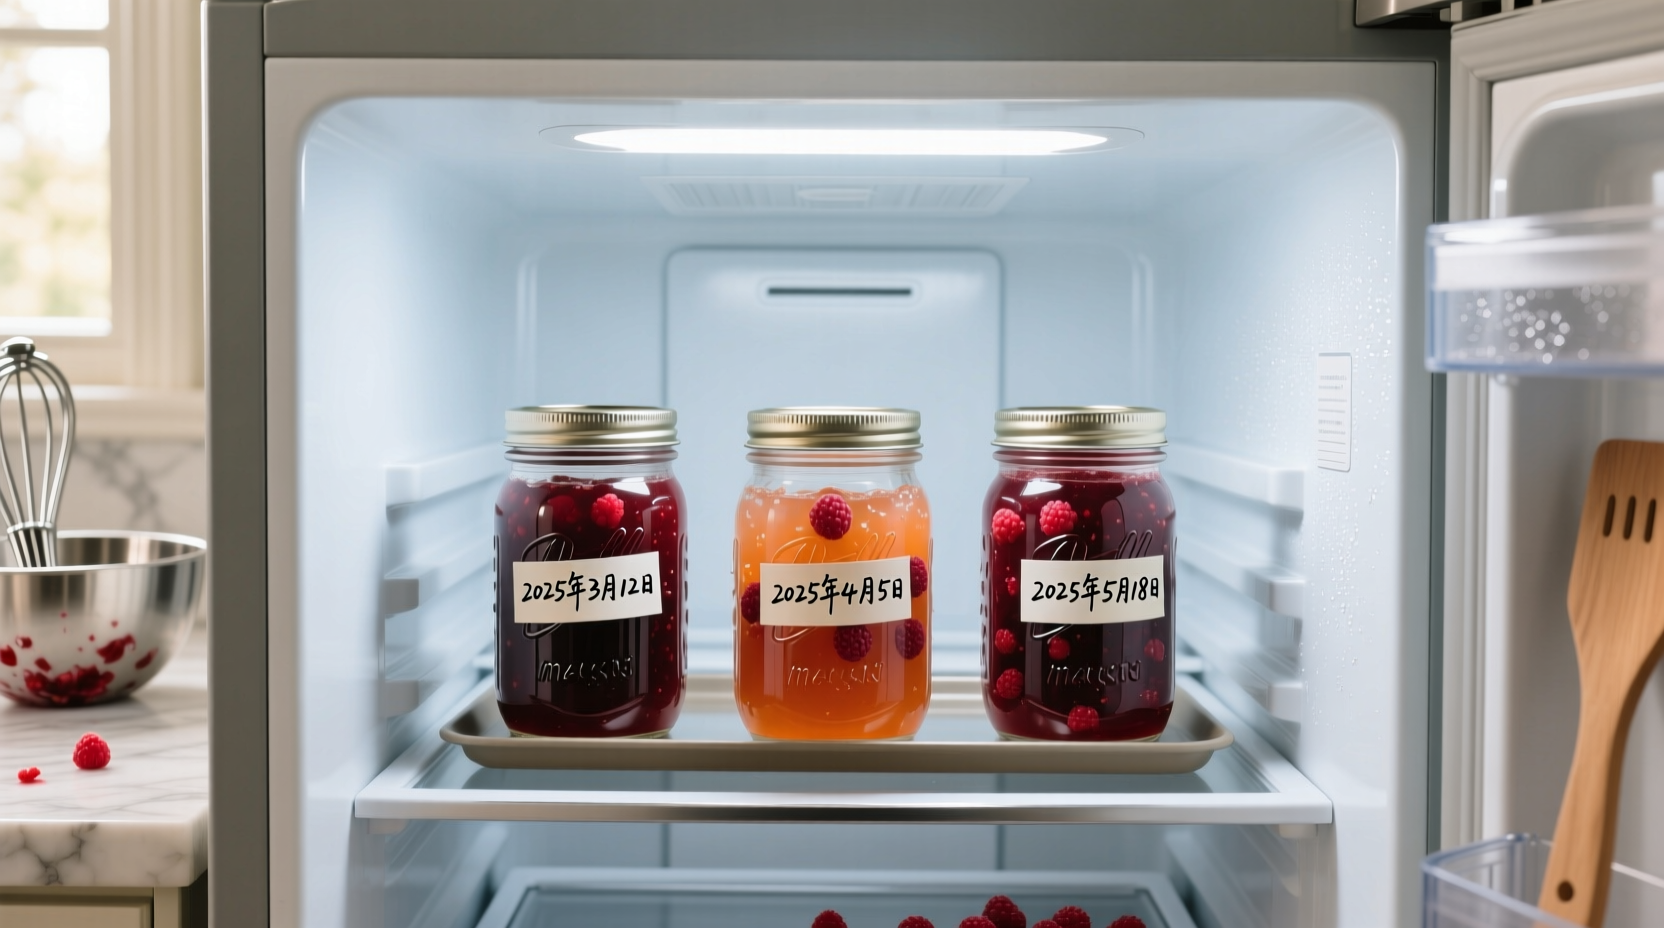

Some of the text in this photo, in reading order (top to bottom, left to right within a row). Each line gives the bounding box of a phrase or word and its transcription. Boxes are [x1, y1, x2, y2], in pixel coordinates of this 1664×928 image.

[522, 571, 652, 611] 2025年3月12日
[772, 574, 902, 615] 2025年4月5日
[1032, 573, 1158, 612] 2025年5月18日
